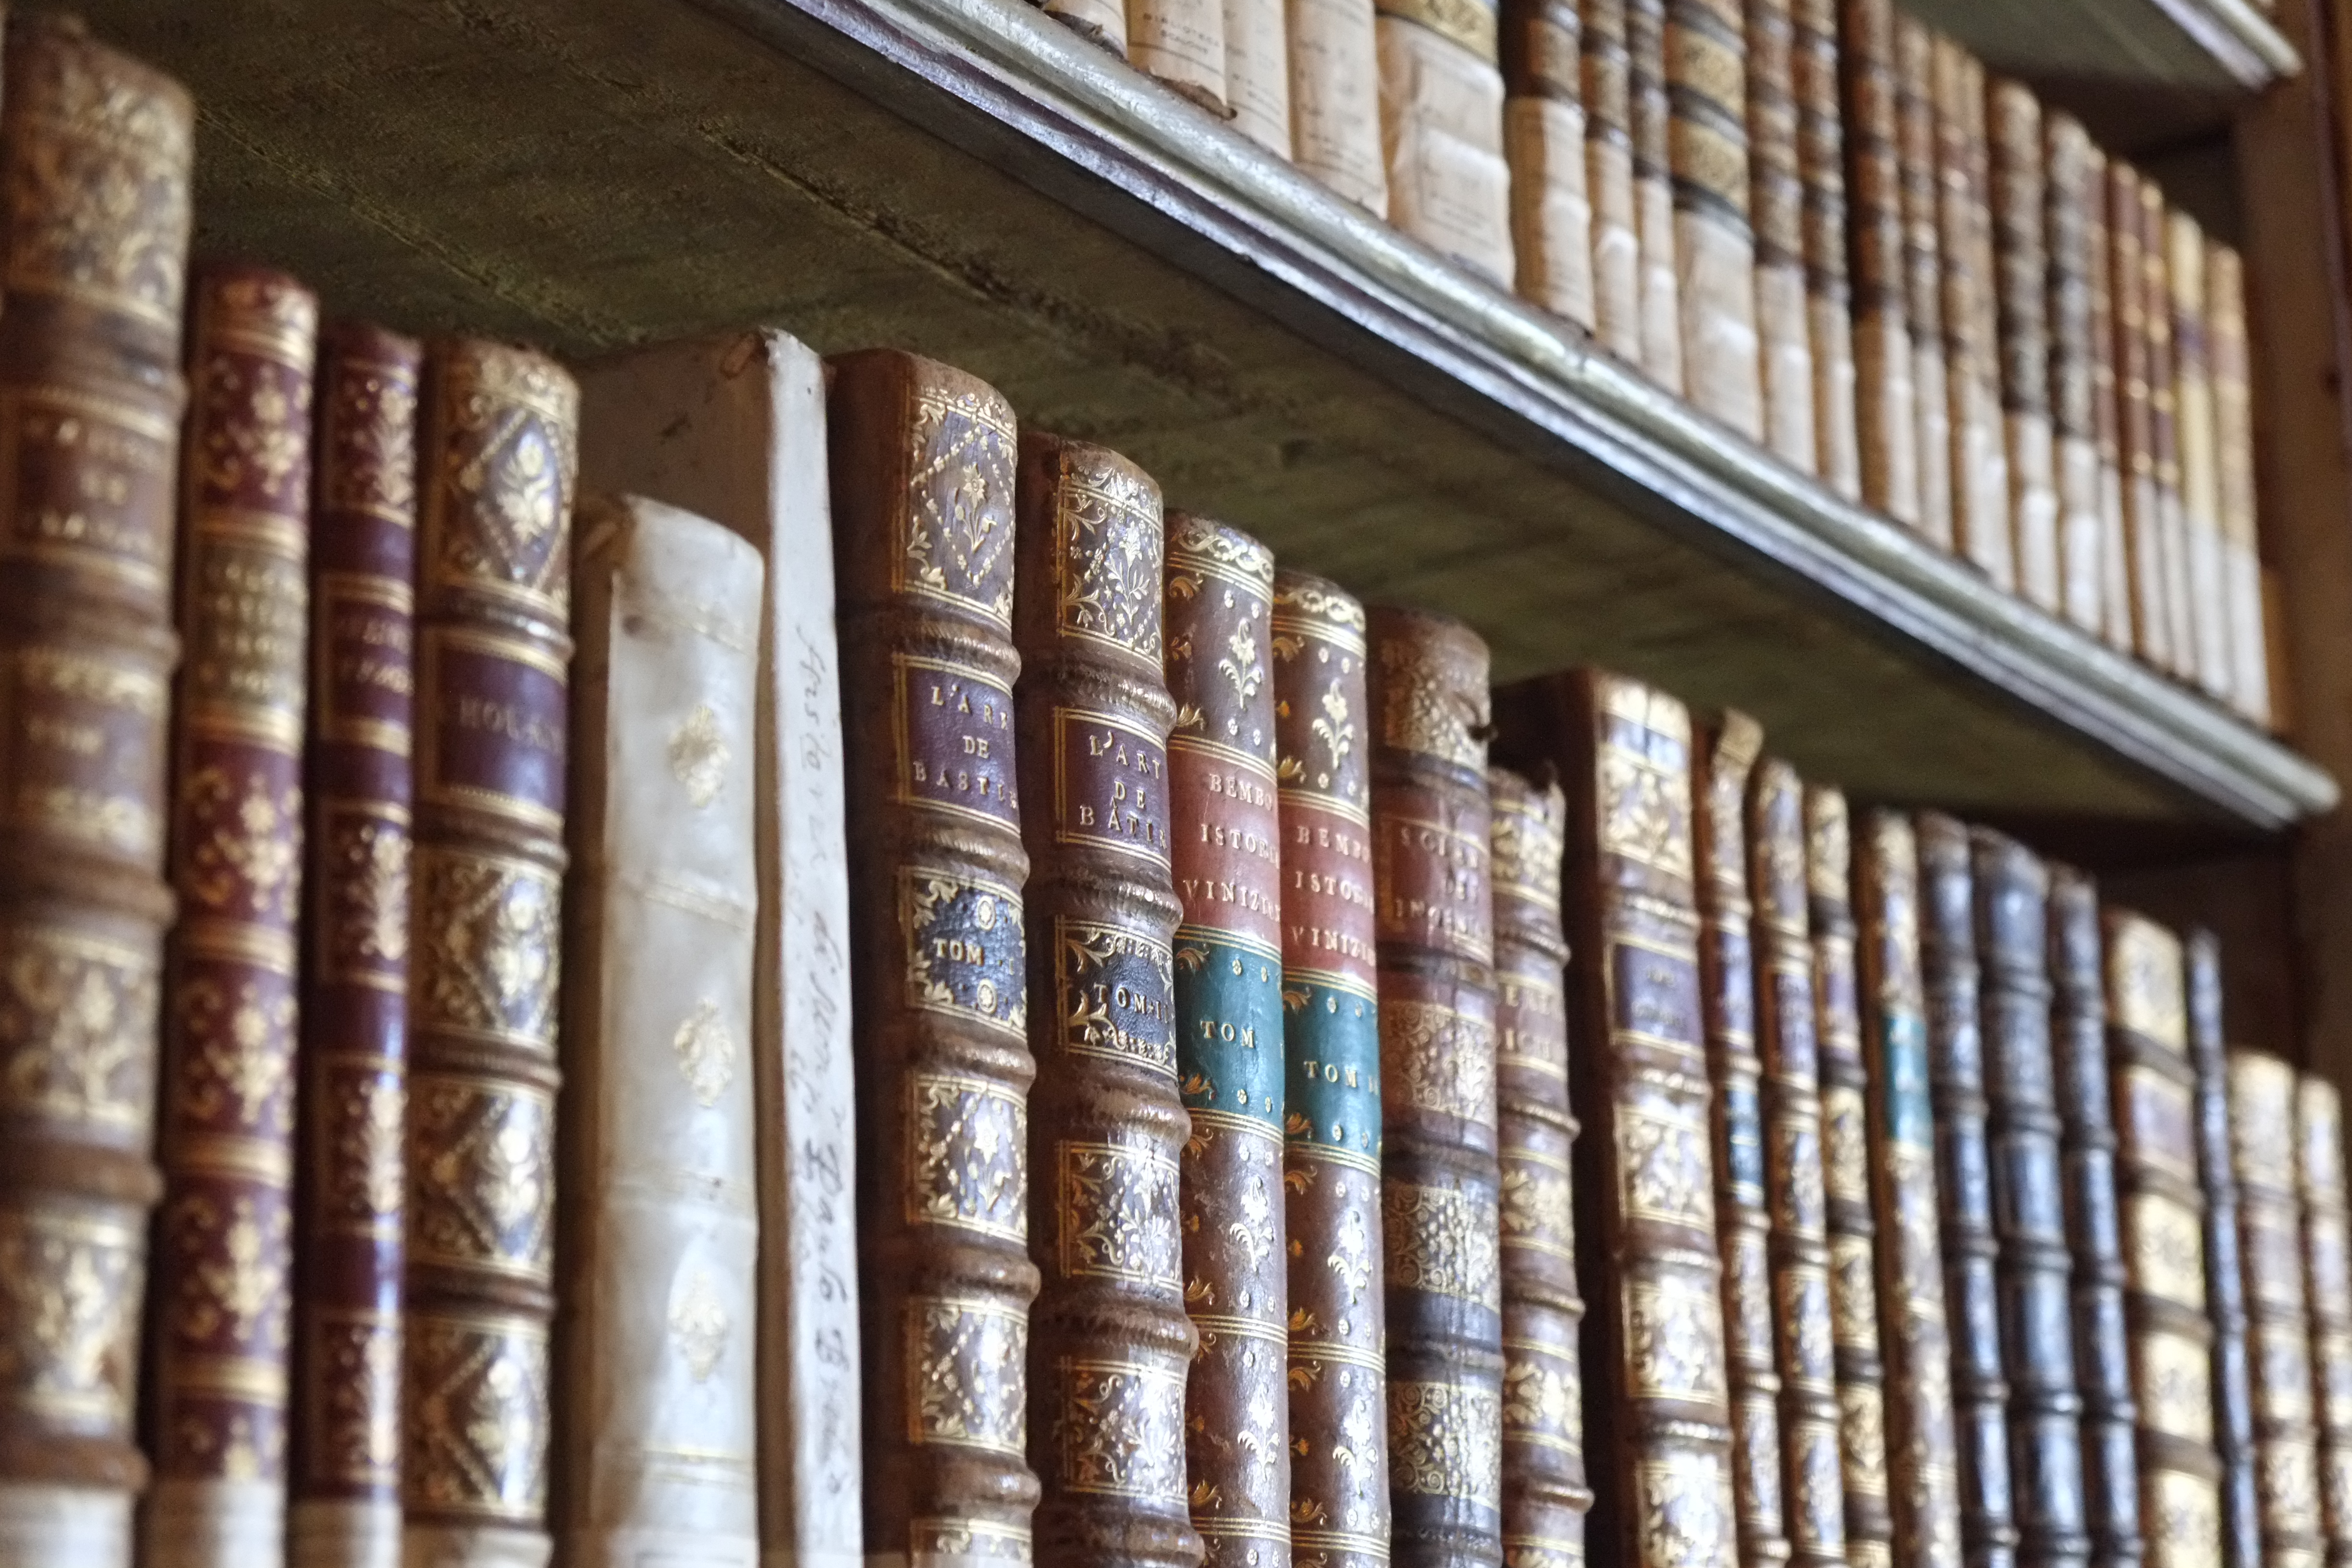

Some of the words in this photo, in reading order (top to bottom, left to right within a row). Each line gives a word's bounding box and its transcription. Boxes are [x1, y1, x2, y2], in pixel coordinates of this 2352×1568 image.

[963, 735, 990, 759] DE
[1090, 729, 1161, 779] L'ART
[1115, 780, 1145, 809] DE
[1209, 773, 1272, 811] BEMBO
[933, 938, 984, 967] TOM
[1093, 982, 1147, 1015] TOM
[1200, 1021, 1254, 1048] TOM
[1304, 1060, 1358, 1088] TOM
